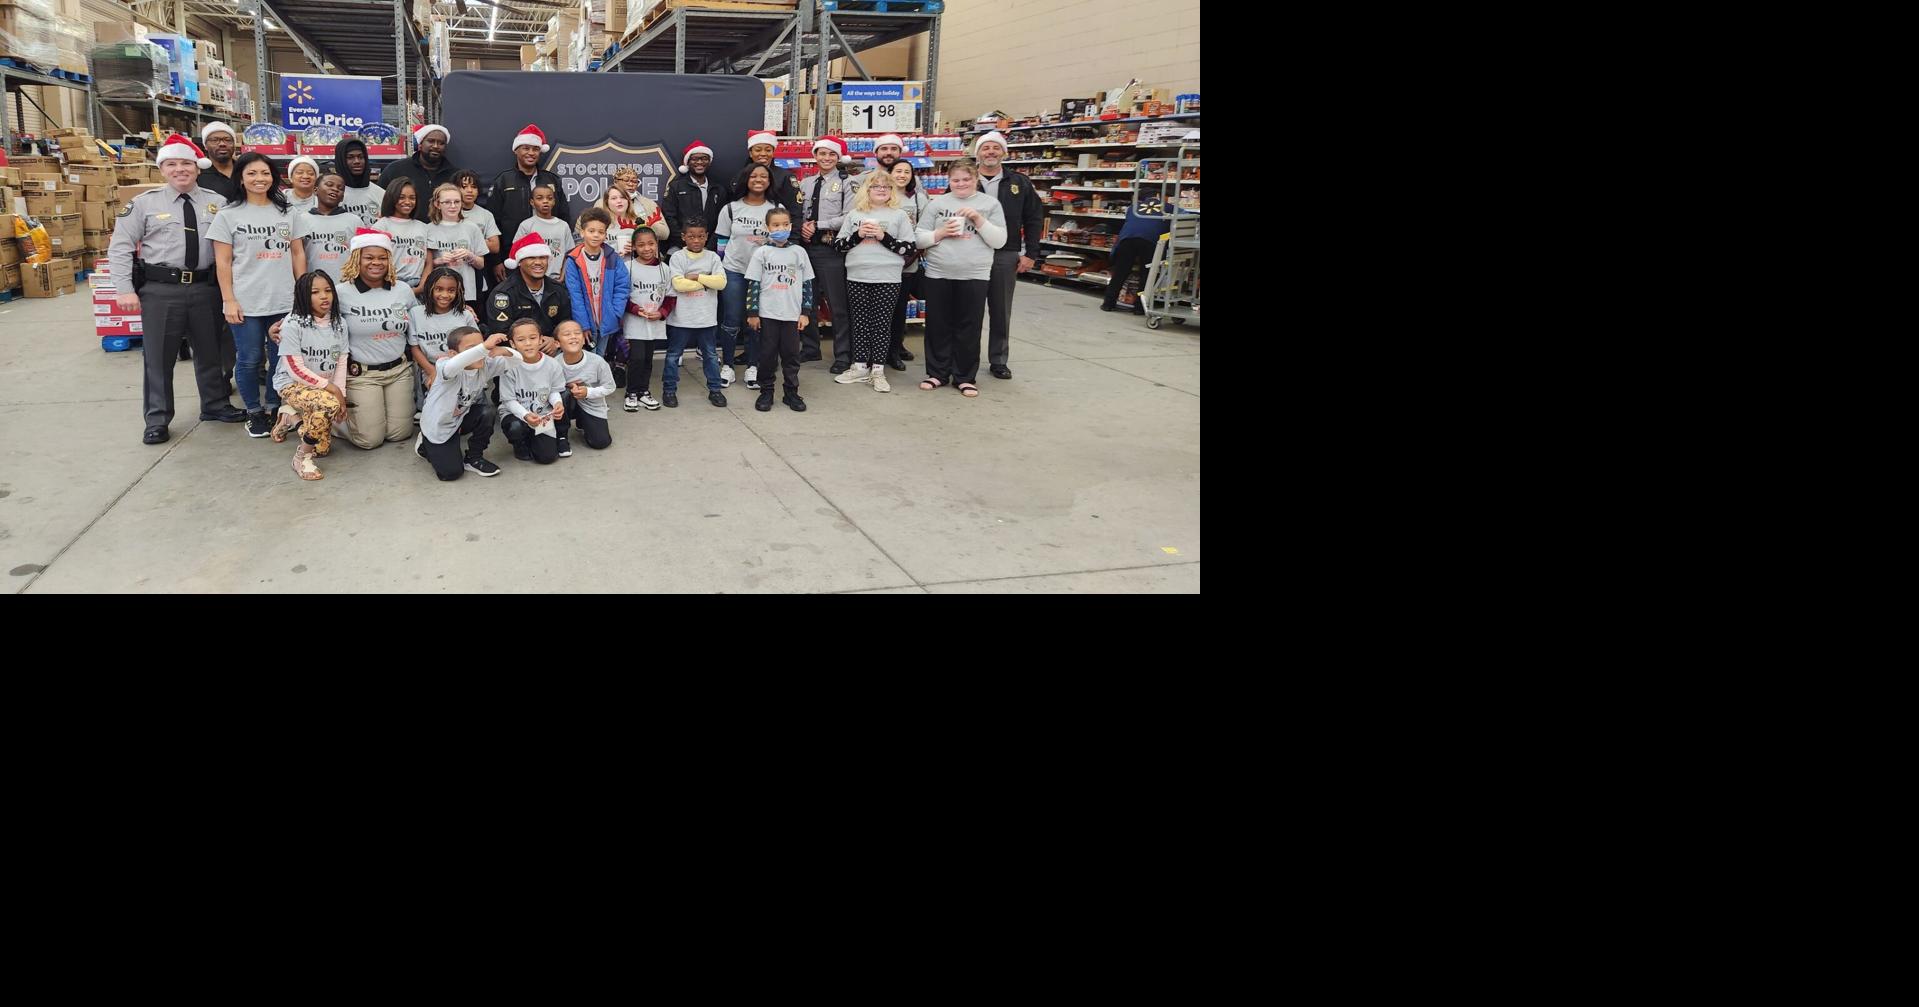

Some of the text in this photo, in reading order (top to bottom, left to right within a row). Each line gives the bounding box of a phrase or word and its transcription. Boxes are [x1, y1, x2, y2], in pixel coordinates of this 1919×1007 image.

[288, 106, 319, 114] Everyday
[289, 113, 363, 127] Low Price
[557, 163, 663, 176] STOCKBDGE
[236, 223, 276, 236] Shop
[305, 231, 335, 241] Shop
[264, 239, 290, 252] Cop
[324, 243, 347, 254] Cop
[633, 280, 658, 291] Shop
[350, 305, 393, 318] Shop
[417, 331, 448, 341] Shop
[300, 346, 330, 359] Shop
